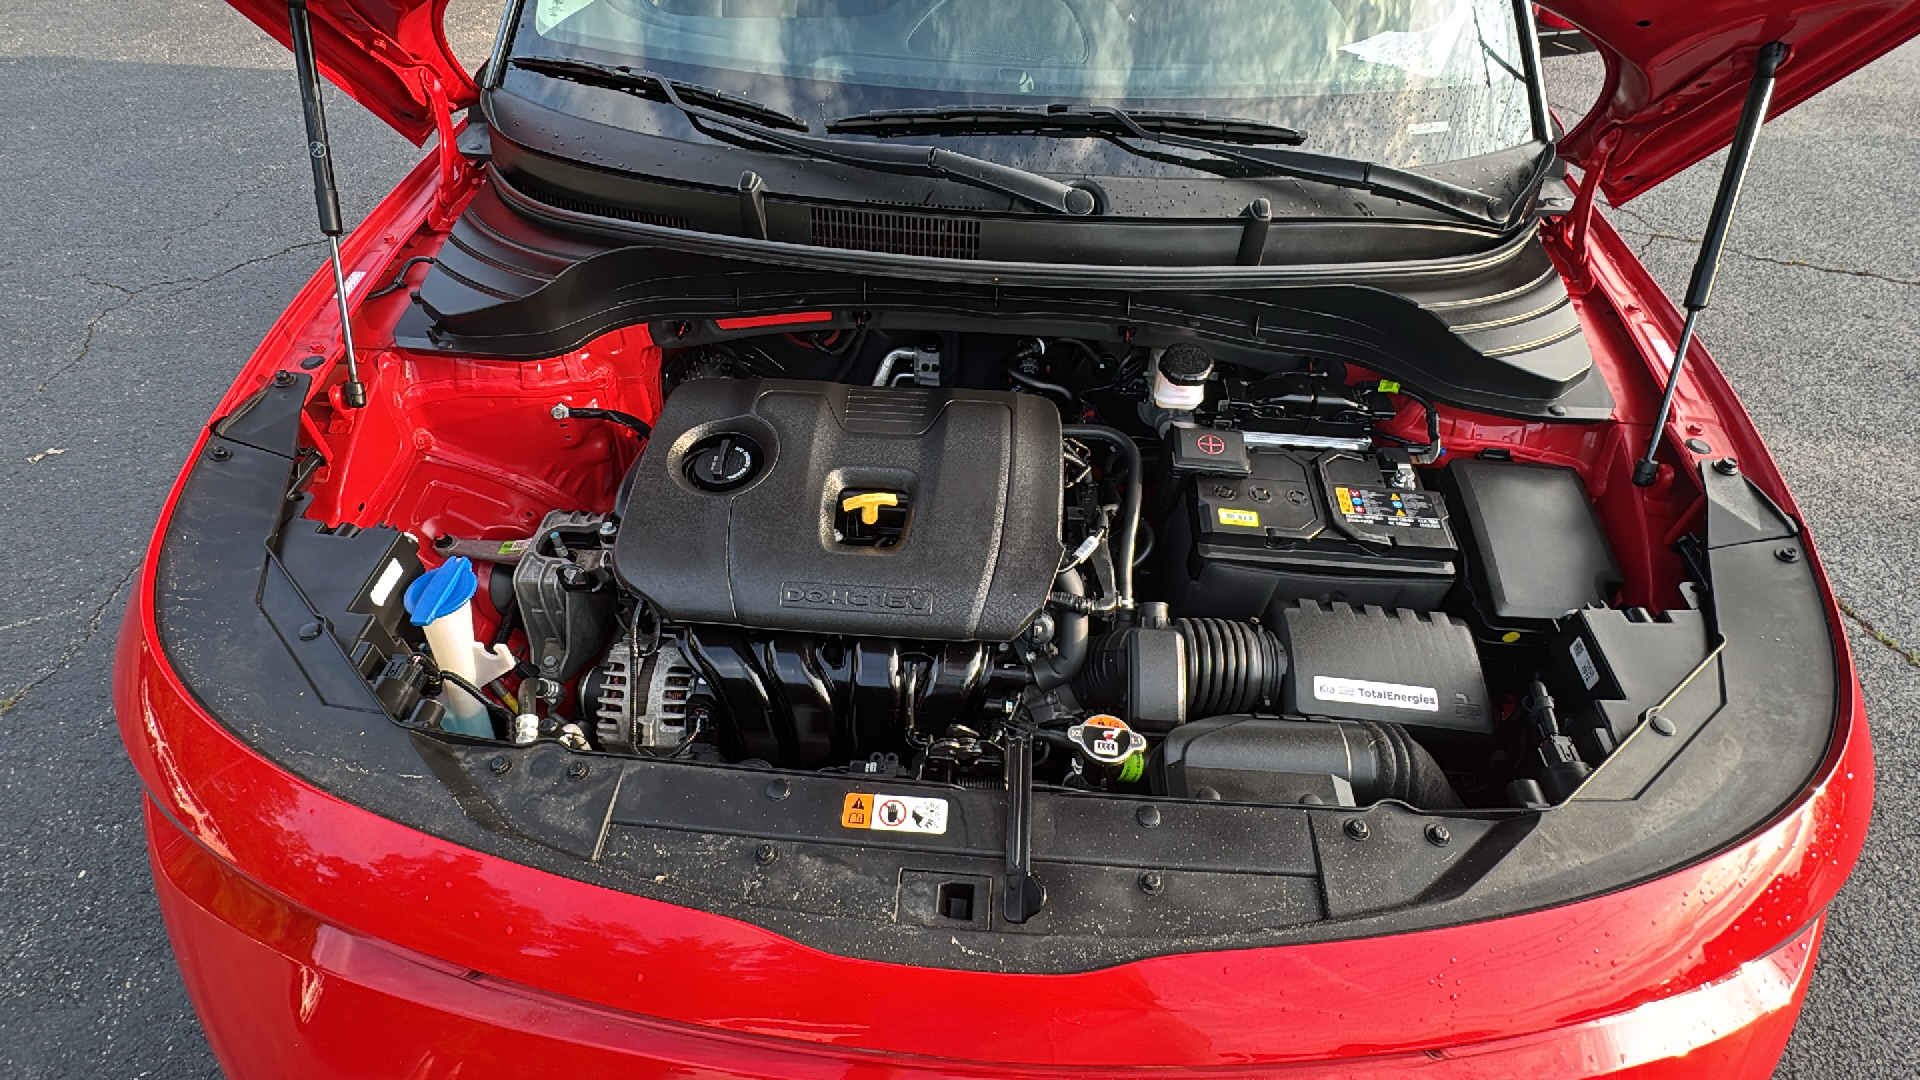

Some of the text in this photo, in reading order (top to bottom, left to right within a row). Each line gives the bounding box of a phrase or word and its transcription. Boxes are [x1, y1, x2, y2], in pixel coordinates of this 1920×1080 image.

[785, 589, 869, 607] DOHC
[1319, 683, 1436, 705] Kia TotalEnergies
